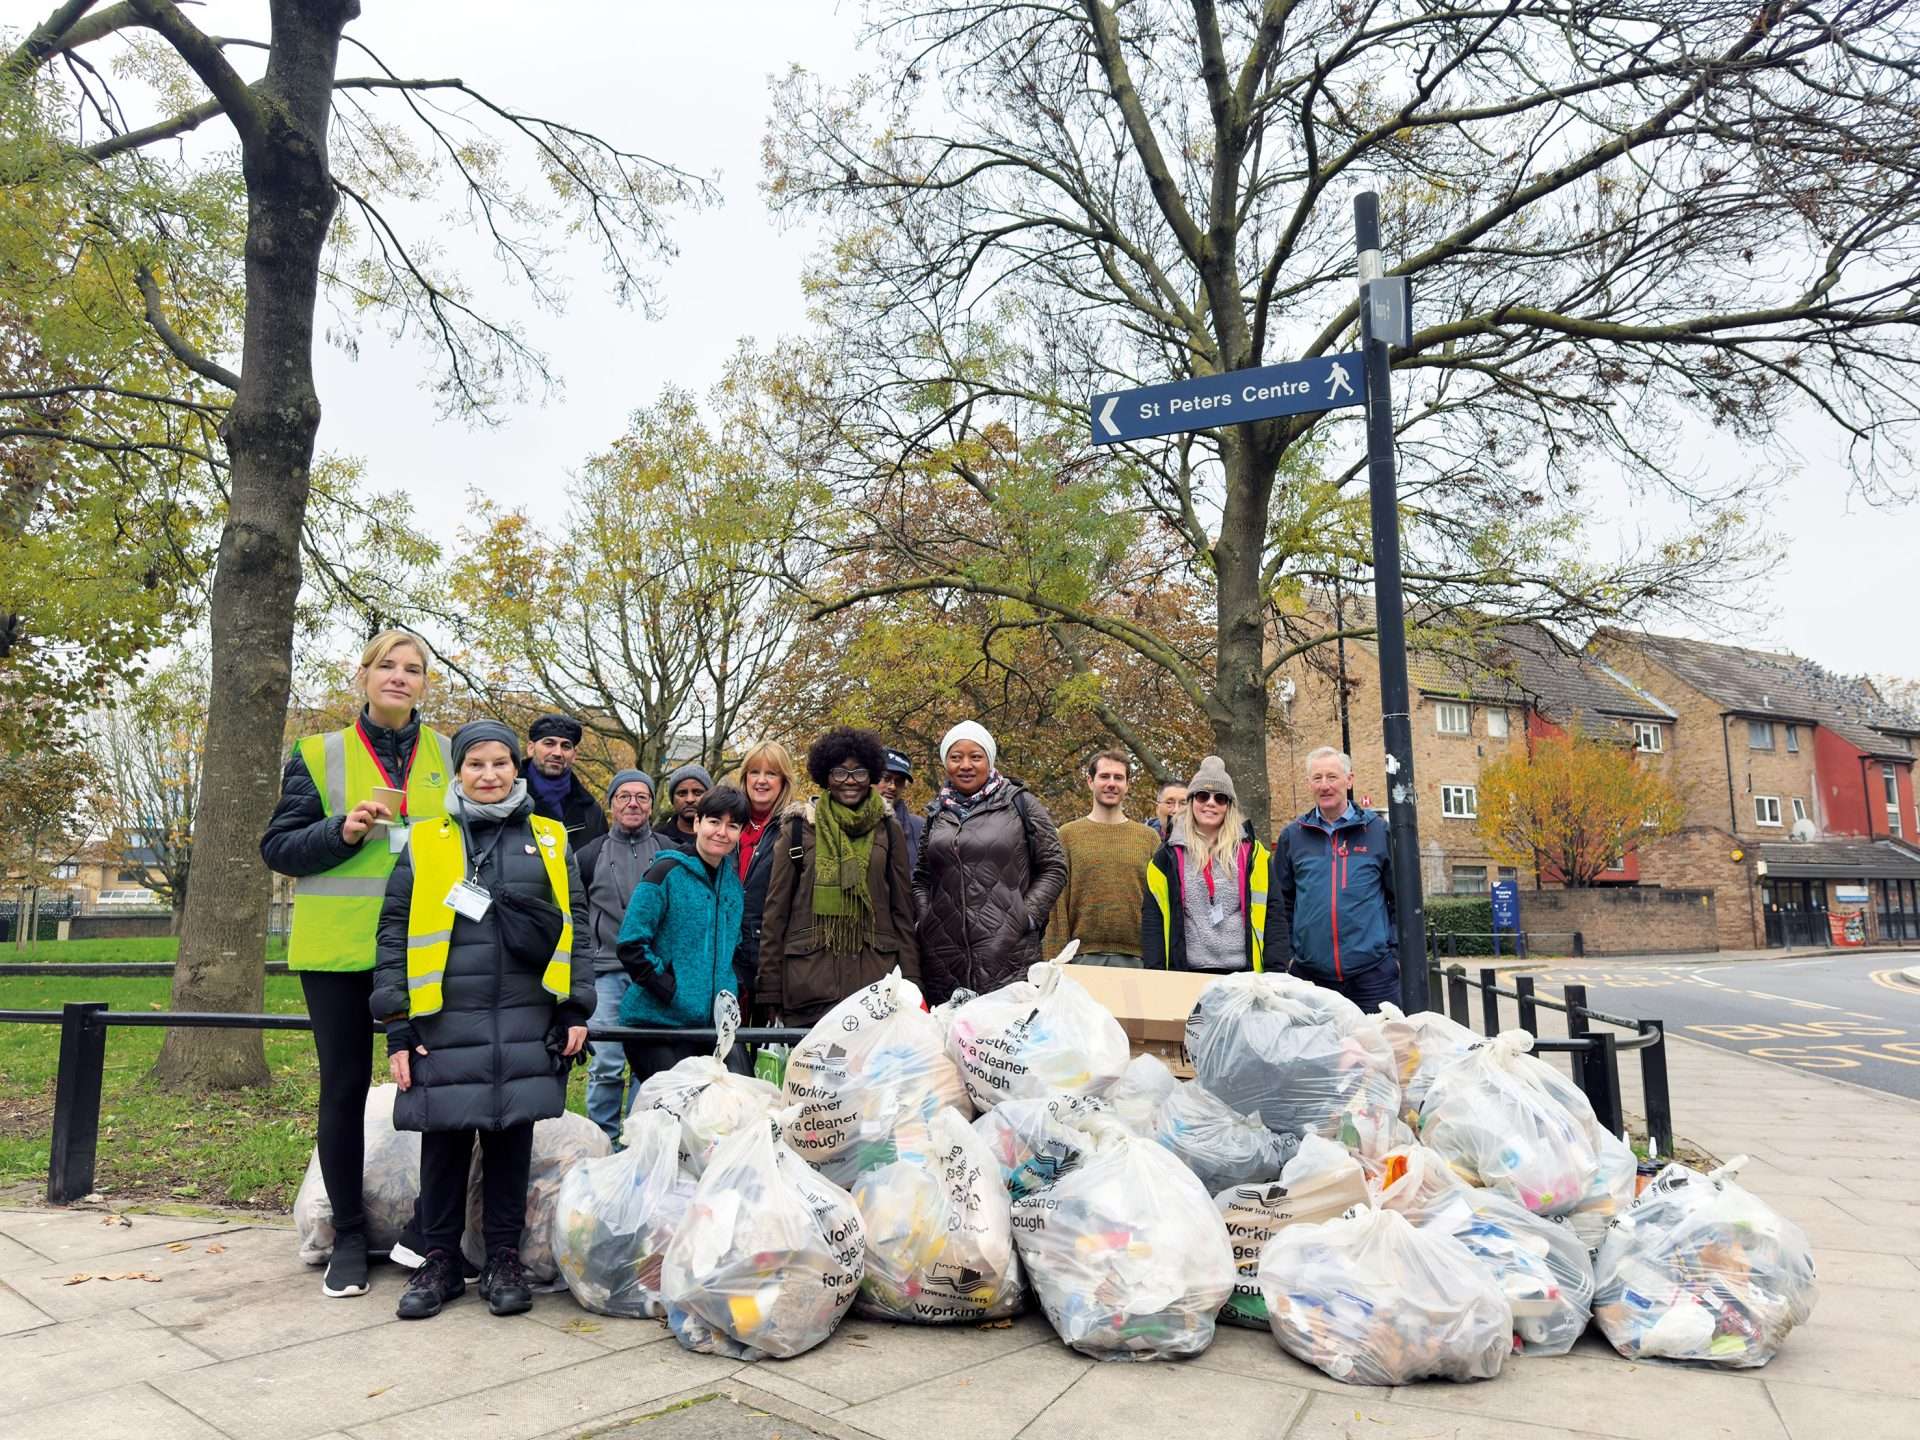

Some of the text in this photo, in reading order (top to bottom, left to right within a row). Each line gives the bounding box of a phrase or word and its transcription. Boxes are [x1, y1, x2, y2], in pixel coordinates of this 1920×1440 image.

[1139, 380, 1311, 419] St Peters Centre
[1684, 1021, 1907, 1041] BUS
[979, 1051, 1029, 1075] cleaner
[1748, 1042, 1920, 1068] ST
[804, 1112, 857, 1131] cleaner
[793, 1131, 845, 1148] borough
